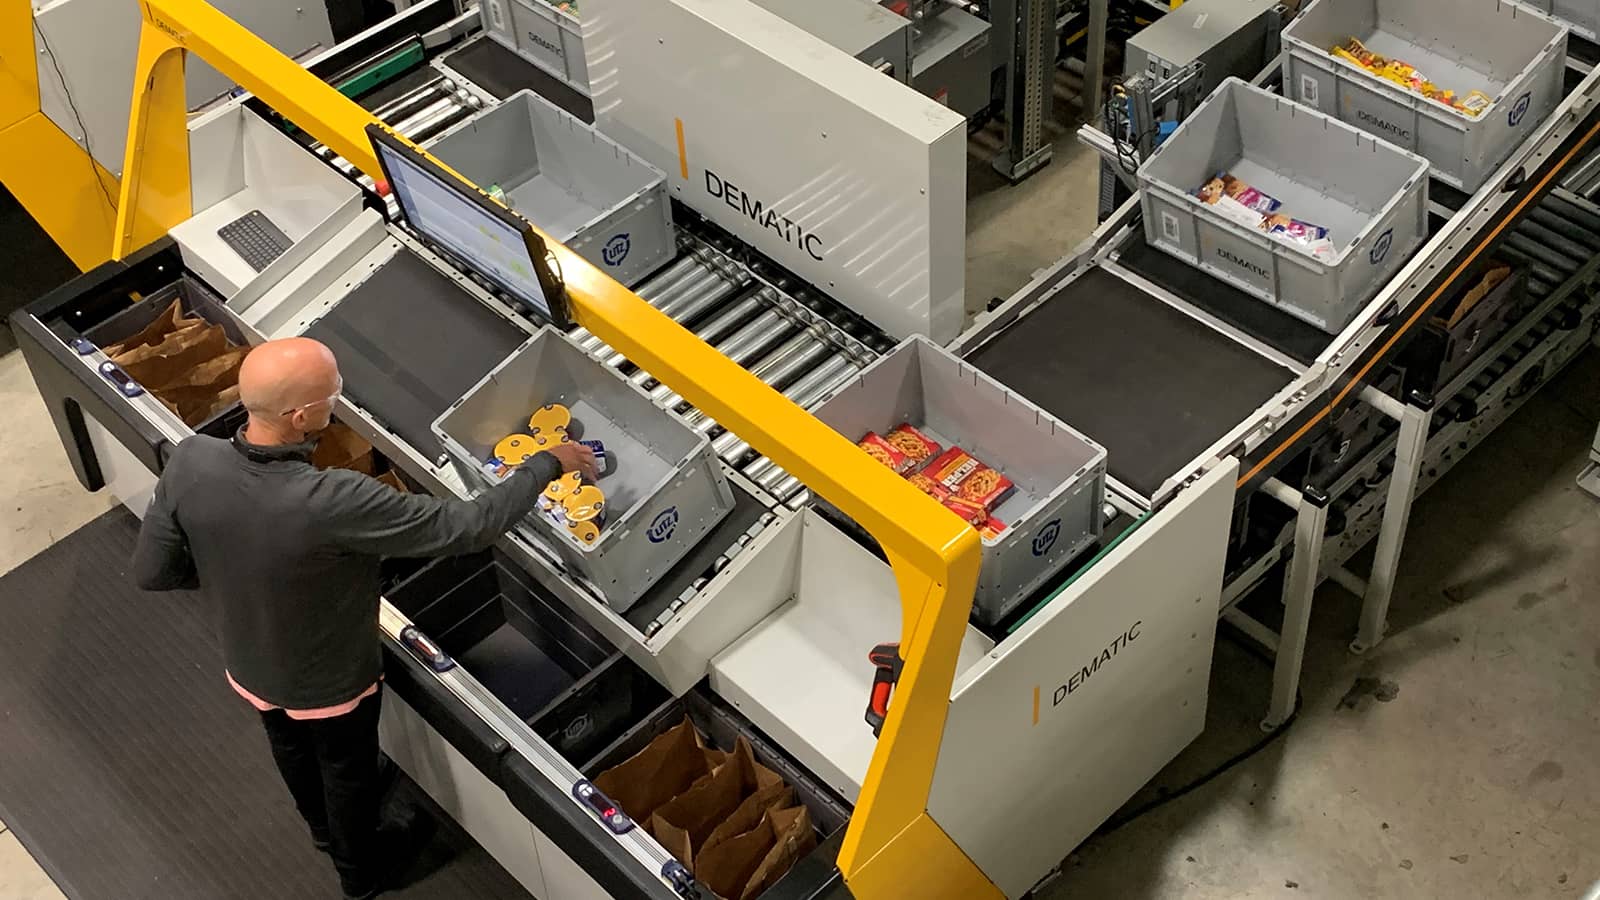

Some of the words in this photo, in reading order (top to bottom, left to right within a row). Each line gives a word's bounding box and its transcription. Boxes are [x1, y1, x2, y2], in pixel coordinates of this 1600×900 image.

[1358, 110, 1410, 140] DEMATIC
[705, 168, 824, 261] DEMATIC
[1217, 248, 1271, 280] DEMATIC
[1053, 620, 1142, 707] DEMATIC
